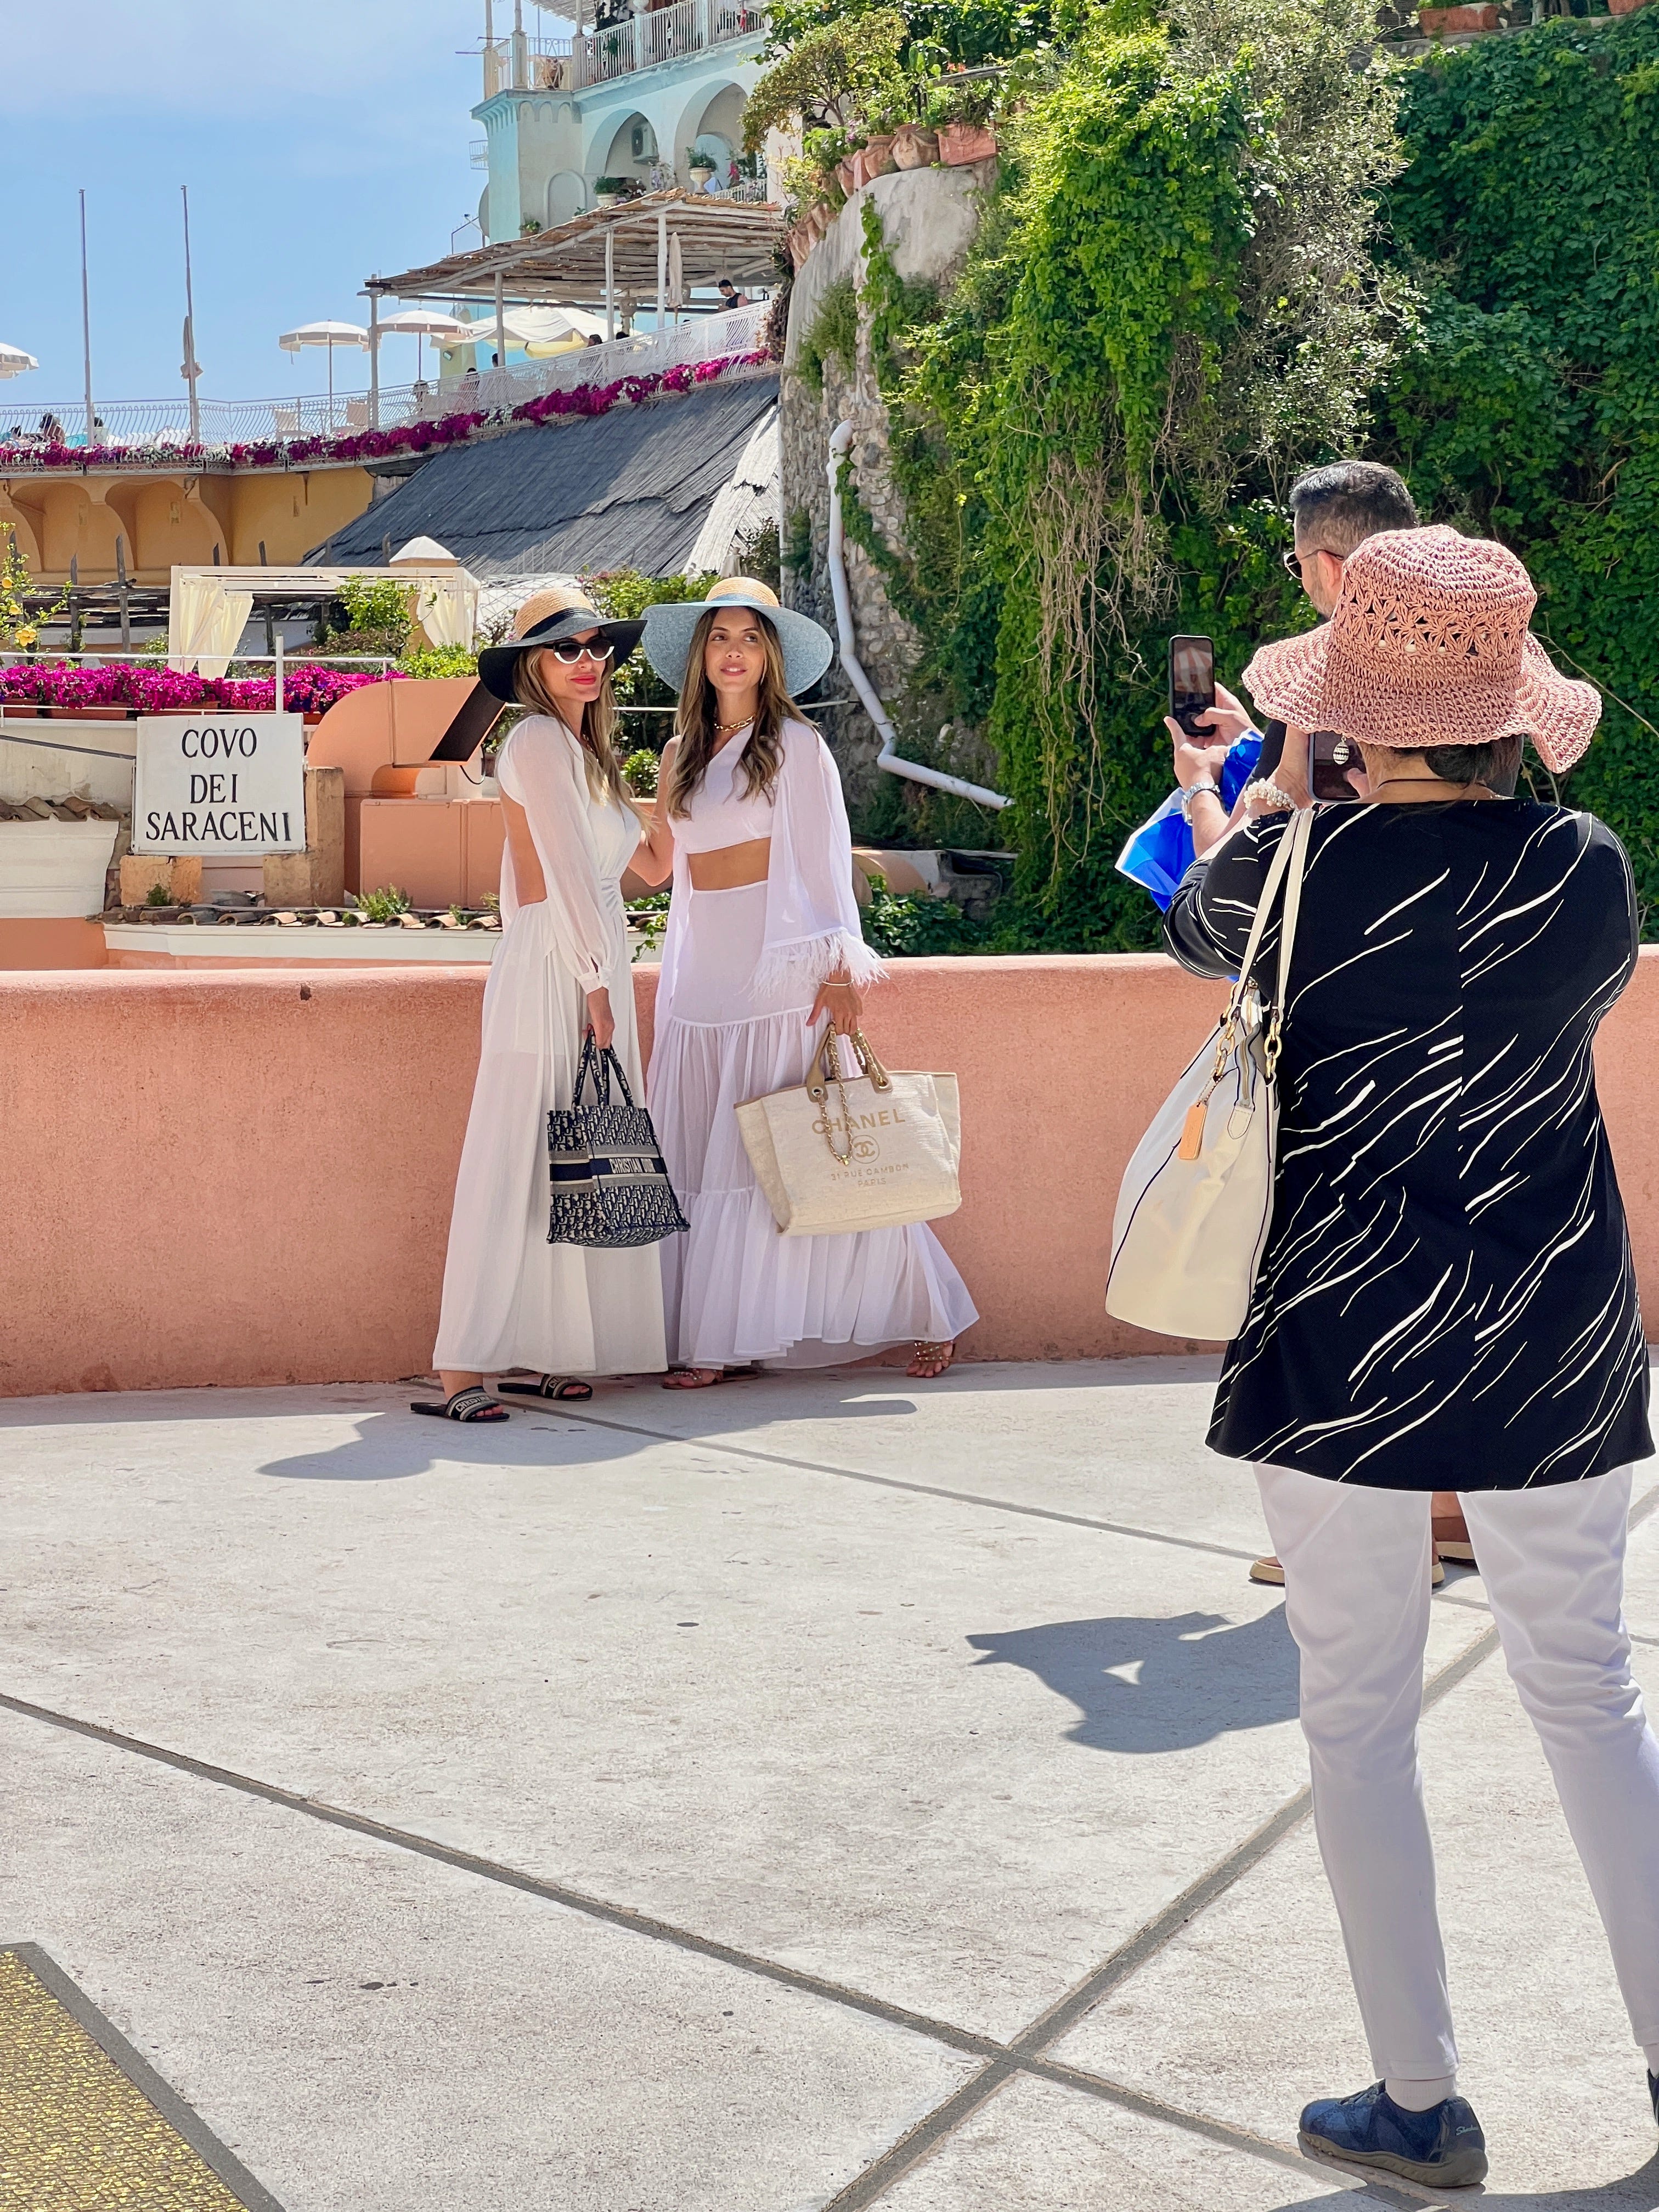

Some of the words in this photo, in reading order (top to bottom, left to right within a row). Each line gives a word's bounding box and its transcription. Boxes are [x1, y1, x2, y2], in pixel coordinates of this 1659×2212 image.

[182, 728, 257, 758] COVO
[190, 774, 238, 804] DEI
[146, 811, 291, 842] SARACENI
[812, 1109, 905, 1135] CHANEL
[858, 1177, 887, 1187] PARIS
[866, 1163, 909, 1175] CAMBON
